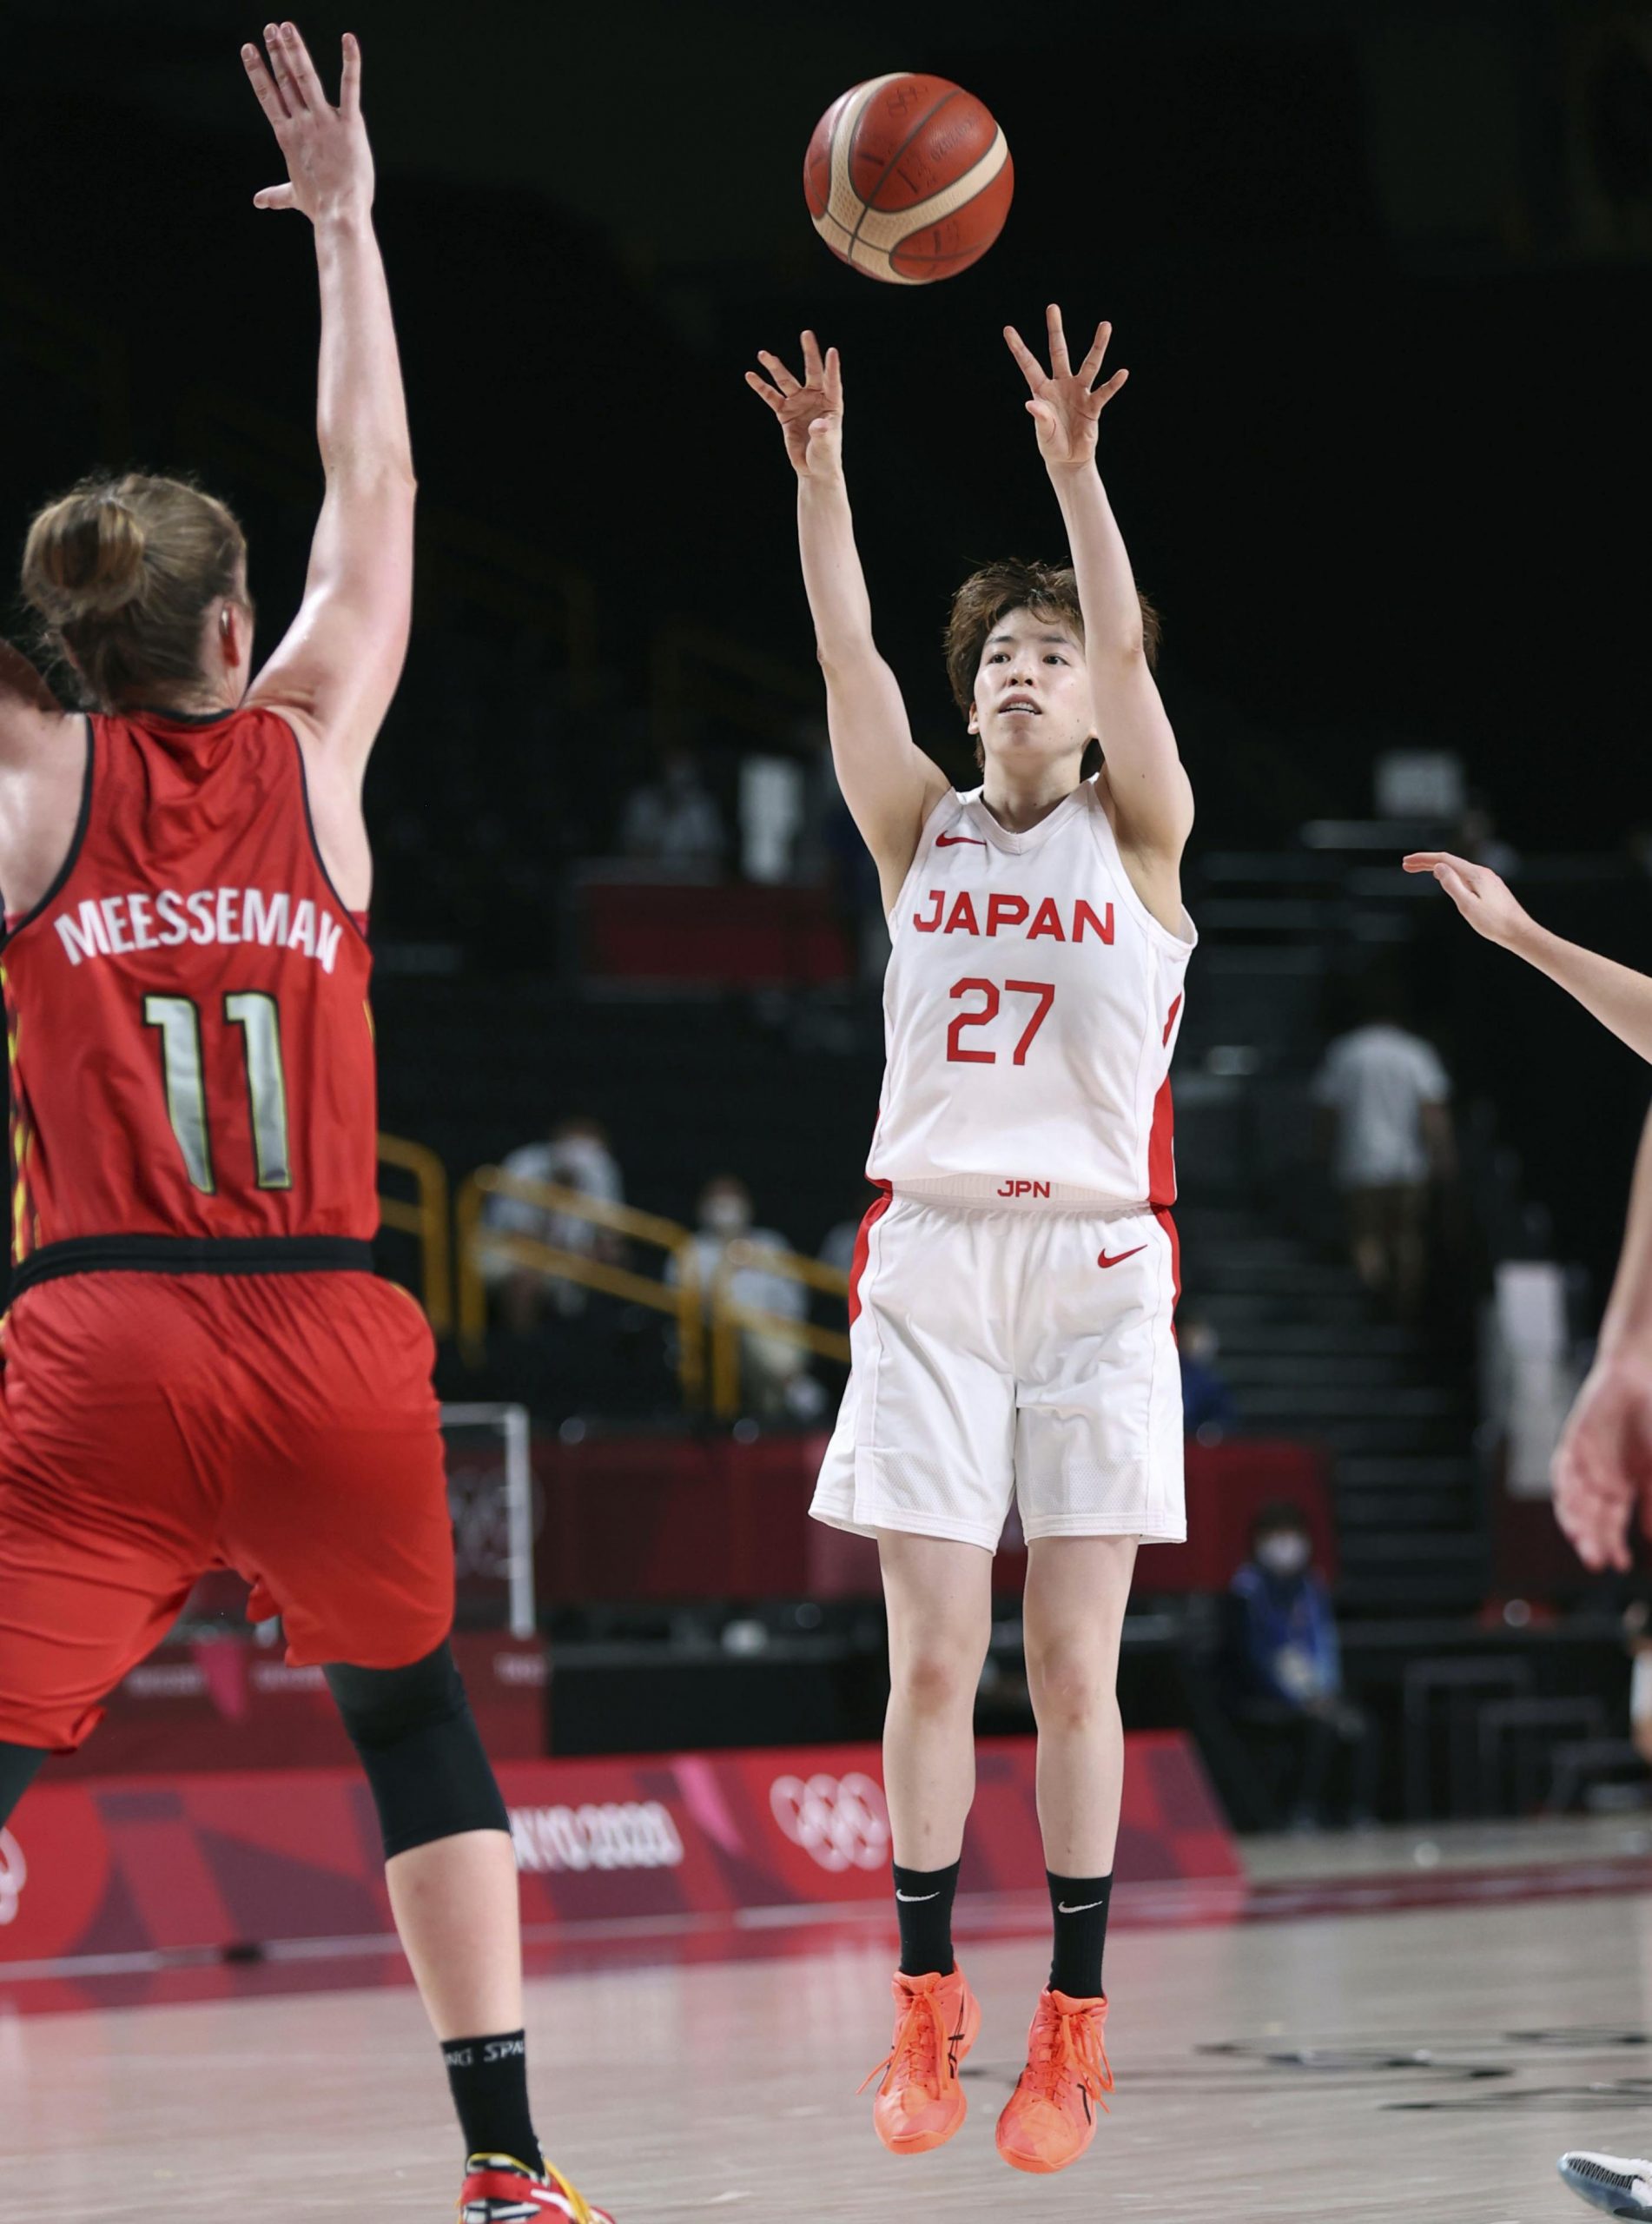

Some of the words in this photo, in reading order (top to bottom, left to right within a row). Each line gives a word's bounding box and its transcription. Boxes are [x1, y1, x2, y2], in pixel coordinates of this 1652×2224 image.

[53, 887, 343, 975] MEESSEMAN
[913, 890, 1115, 946] JAPAN
[947, 977, 1055, 1066] 27
[143, 991, 293, 1195] 11
[997, 1180, 1050, 1198] JPN
